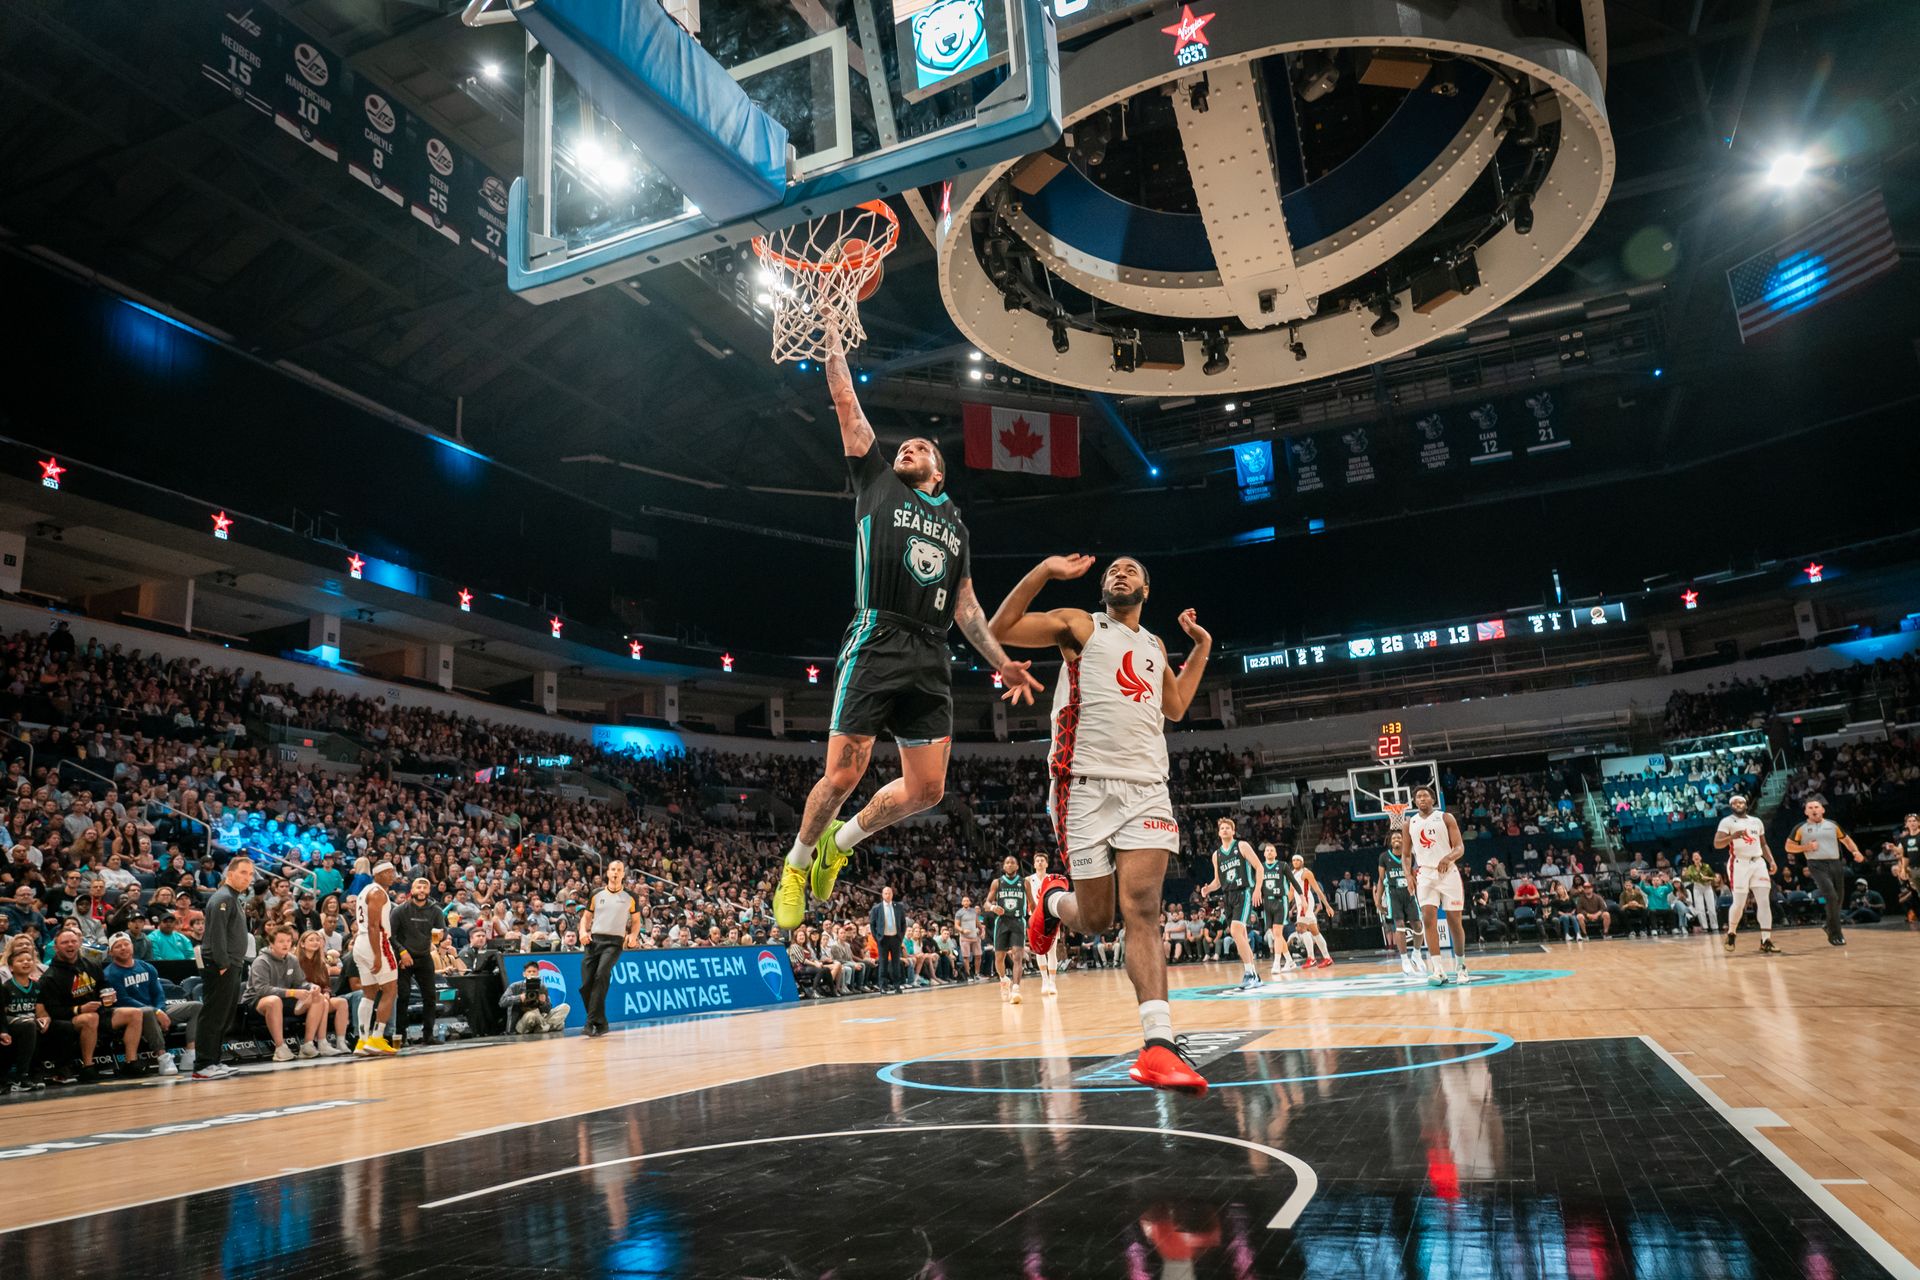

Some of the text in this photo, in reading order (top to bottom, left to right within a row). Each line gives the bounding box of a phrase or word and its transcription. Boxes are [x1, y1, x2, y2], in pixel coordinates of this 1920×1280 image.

[220, 32, 262, 69] HEDBERG
[1177, 47, 1207, 67] 103.1
[1179, 43, 1204, 55] RADIO
[228, 55, 253, 86] 15
[285, 73, 332, 115] HAWERCHUK
[297, 97, 320, 125] 10
[363, 127, 394, 155] CARLYLE
[371, 149, 384, 170] 8
[428, 173, 451, 194] STEEN
[429, 188, 449, 214] 25
[486, 224, 501, 247] 27
[1538, 427, 1555, 442] 21
[1482, 440, 1498, 453] 12
[893, 508, 922, 532] SEA
[922, 519, 962, 557] BEARS
[934, 587, 948, 611] 8
[1380, 635, 1404, 654] 26
[1447, 625, 1470, 644] 13
[1145, 658, 1155, 673] 2
[1249, 654, 1284, 669] 02:23 PM
[1381, 721, 1402, 734] 1:33
[1378, 735, 1401, 757] 22
[1273, 887, 1282, 896] 33
[357, 905, 365, 924] 3
[648, 959, 698, 982] HOME
[700, 955, 747, 978] TEAM
[623, 984, 732, 1015] ADVANTAGE
